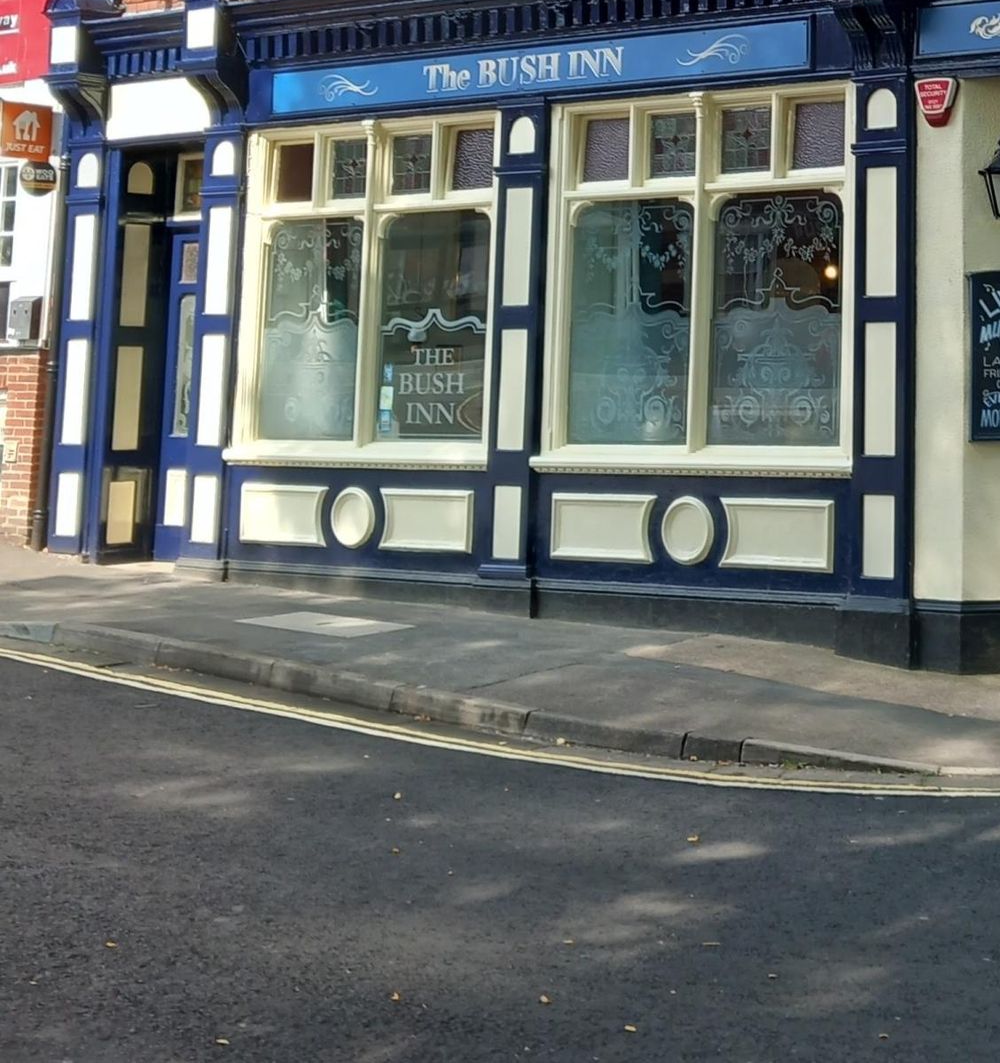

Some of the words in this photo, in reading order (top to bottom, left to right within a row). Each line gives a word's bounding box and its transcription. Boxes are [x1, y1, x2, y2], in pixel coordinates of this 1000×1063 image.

[423, 63, 470, 93] The
[477, 52, 561, 89] BUSH
[567, 46, 624, 80] INN
[5, 142, 27, 152] JUST
[28, 144, 46, 154] EAT
[413, 348, 455, 366] THE
[398, 372, 465, 395] BUSH
[405, 402, 455, 424] INN
